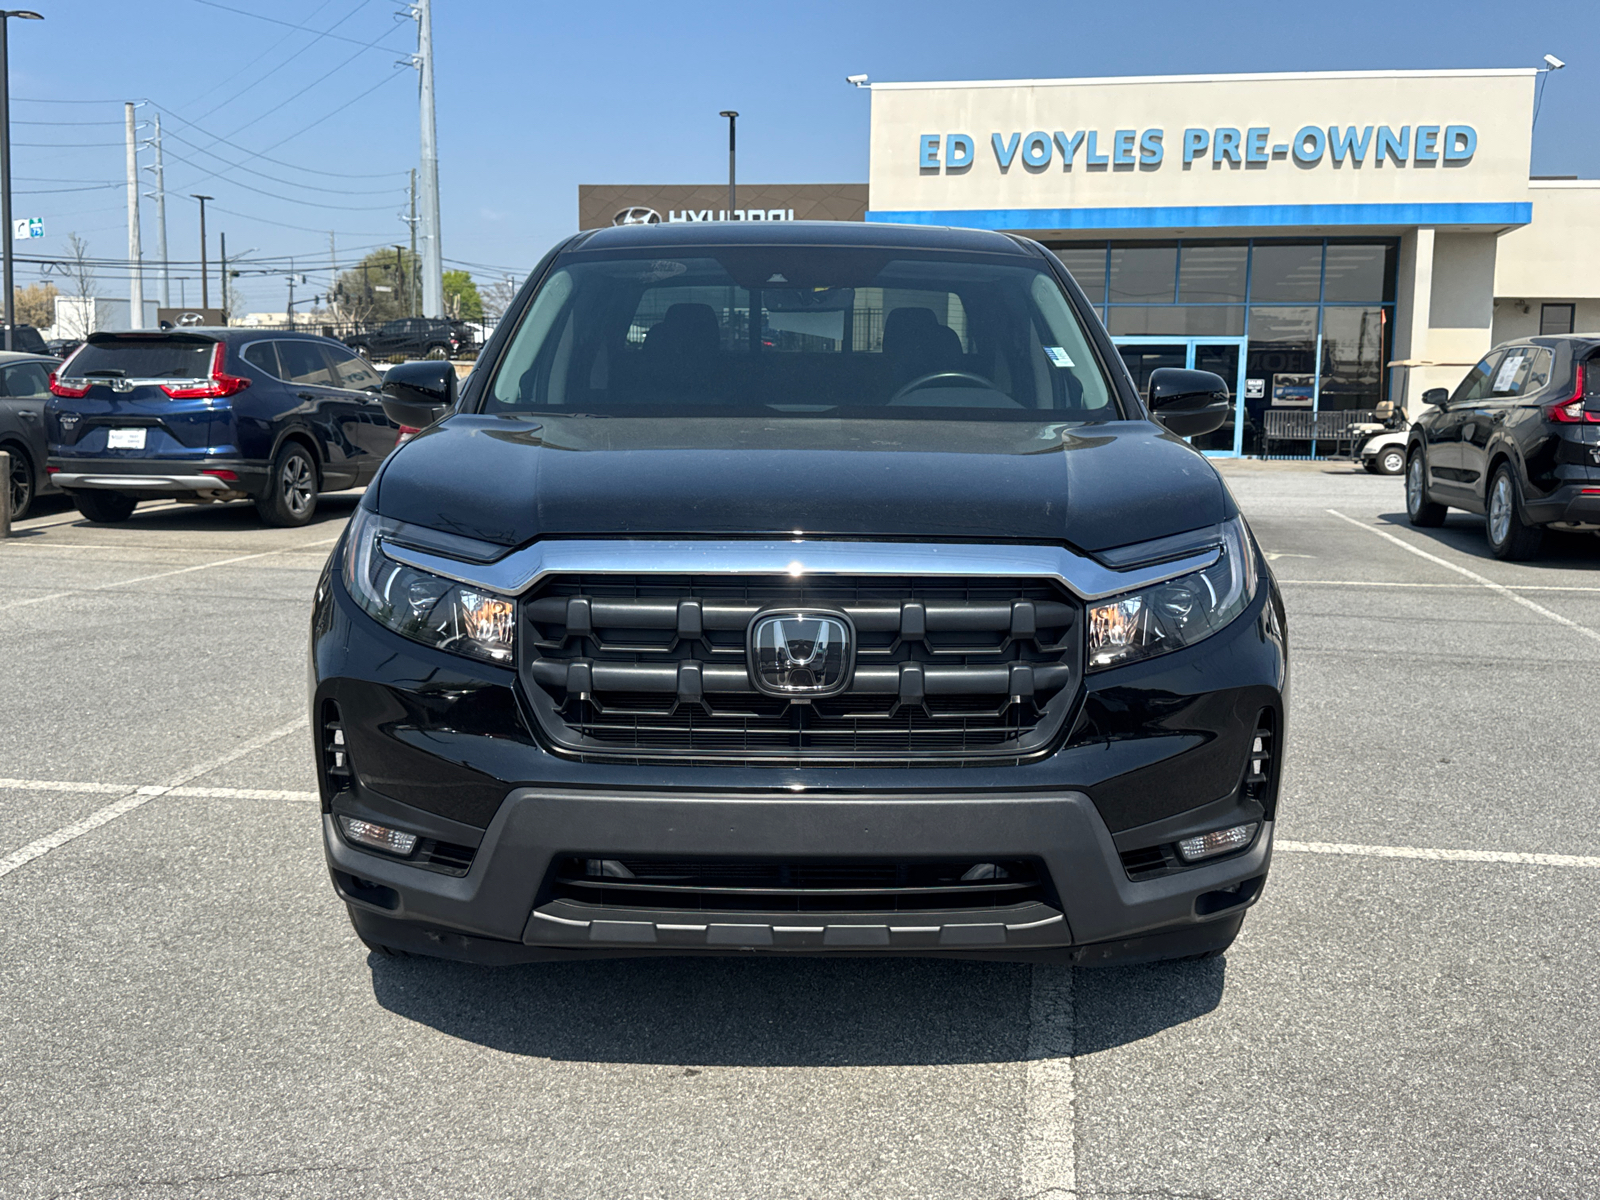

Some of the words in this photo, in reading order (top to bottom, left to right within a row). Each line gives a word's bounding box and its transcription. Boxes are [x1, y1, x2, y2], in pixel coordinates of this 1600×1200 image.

[919, 133, 975, 168] ED
[990, 129, 1164, 168] VOYLES
[1182, 125, 1478, 164] PRE-OWNED
